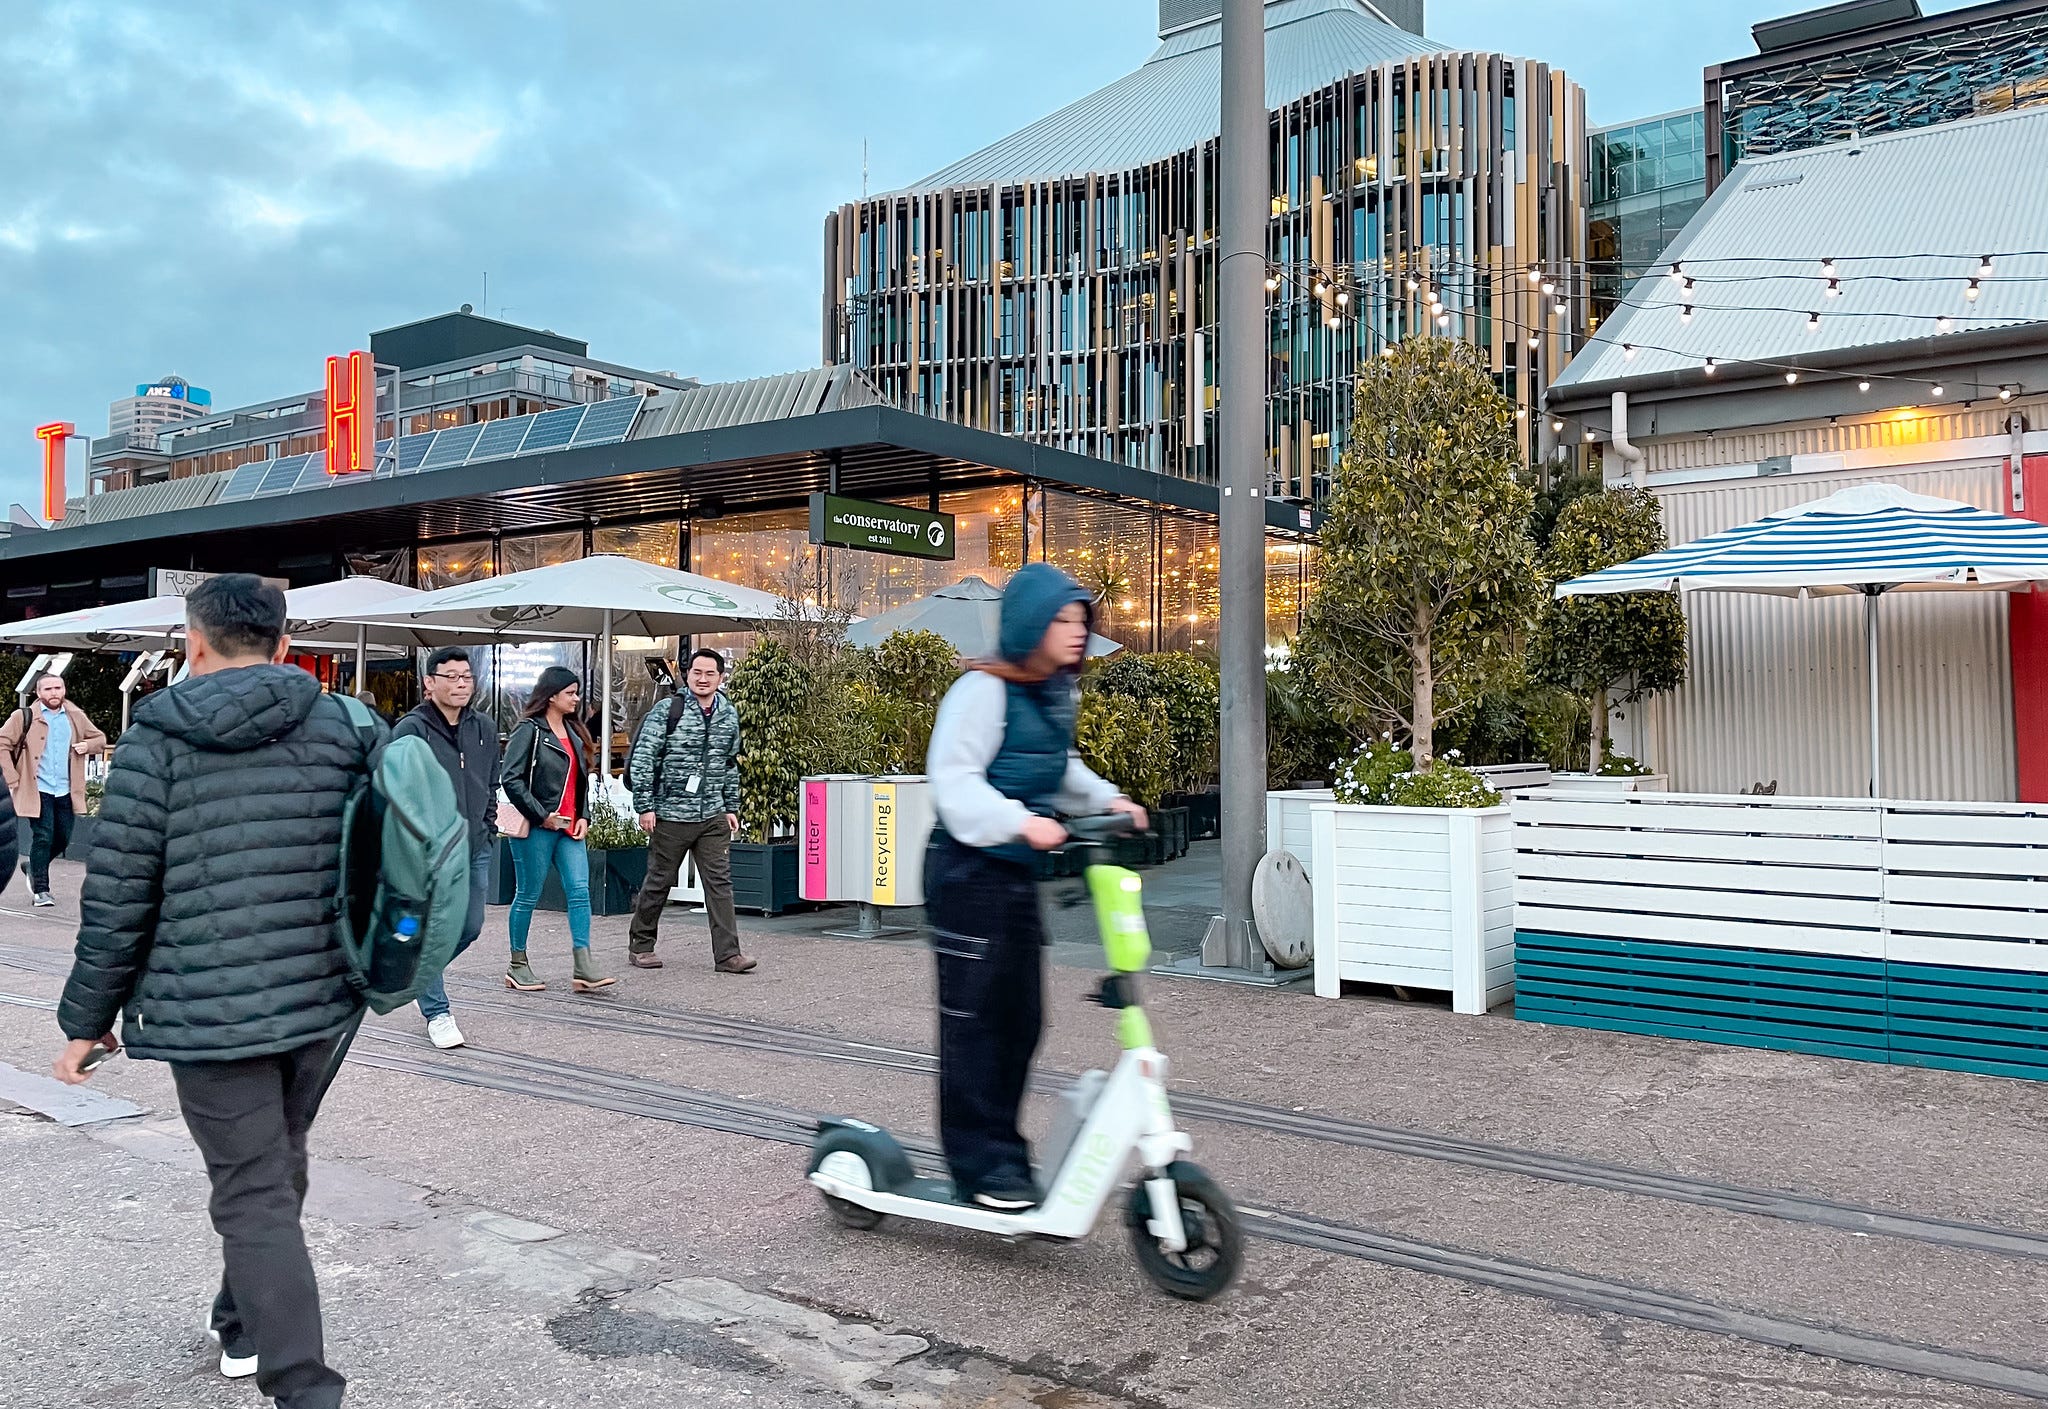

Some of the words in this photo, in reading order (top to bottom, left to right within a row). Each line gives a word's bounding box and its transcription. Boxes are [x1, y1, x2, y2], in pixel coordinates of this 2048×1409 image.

[146, 387, 172, 396] ANZ
[327, 351, 373, 475] H
[36, 422, 74, 521] T
[833, 515, 843, 524] the
[843, 513, 920, 539] conservatory
[868, 535, 878, 543] est
[879, 536, 892, 545] 2011
[808, 820, 820, 865] Litter
[876, 805, 891, 887] Recycling
